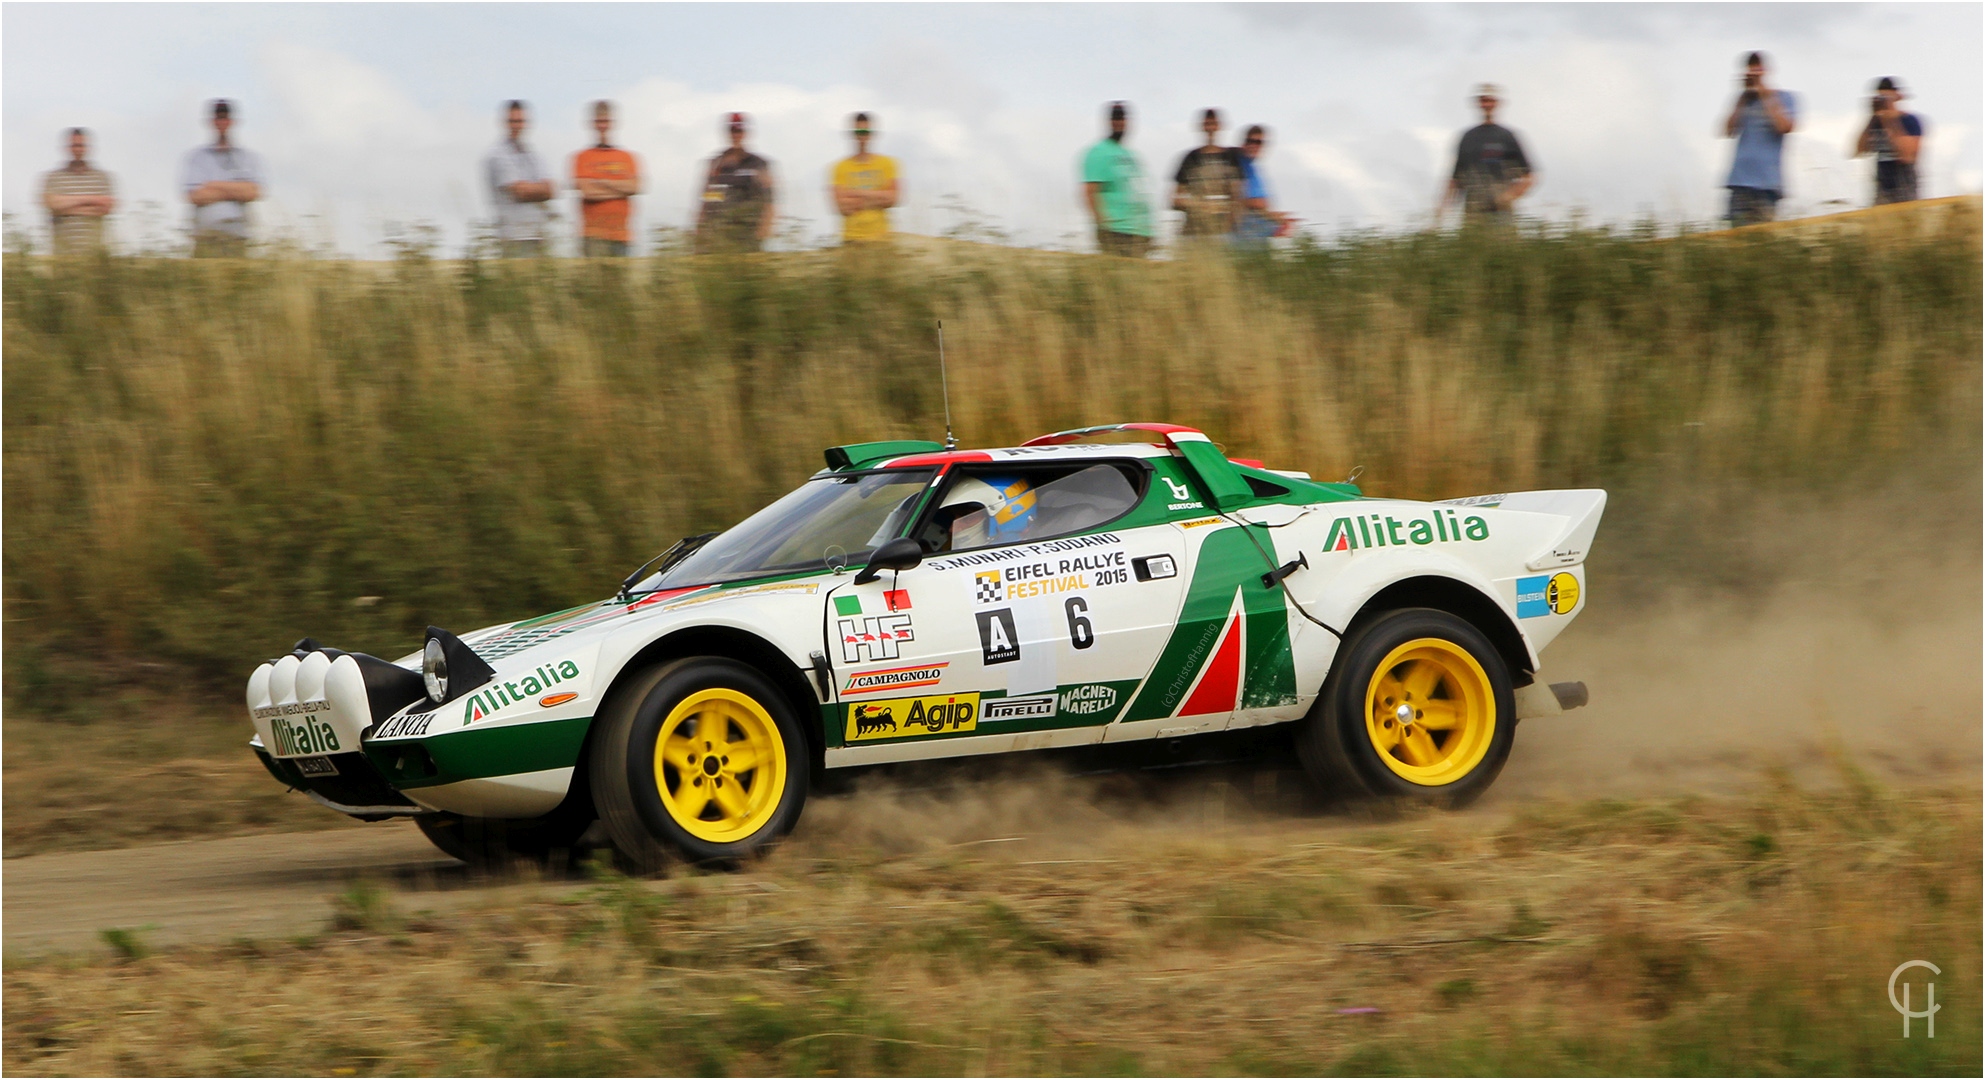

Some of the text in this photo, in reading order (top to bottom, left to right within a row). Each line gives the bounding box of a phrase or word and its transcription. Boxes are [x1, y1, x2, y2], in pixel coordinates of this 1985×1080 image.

[1168, 502, 1204, 510] BERTONE
[1321, 509, 1490, 552] Alitalia
[1005, 551, 1126, 582] EIFEL RALLYE
[1007, 568, 1127, 599] FESTIVAL 2015
[1517, 590, 1546, 603] BILSTEIN
[837, 613, 915, 664] HF
[990, 615, 1012, 653] A
[1064, 596, 1094, 650] 6
[463, 660, 580, 726] Alitalia
[858, 669, 941, 687] CAMPAGNOLO
[904, 697, 972, 733] Agip
[984, 698, 1053, 718] PIRELLI
[1060, 696, 1117, 714] MARELLI
[271, 715, 341, 756] Alitalia
[375, 713, 437, 739] LANCIA
